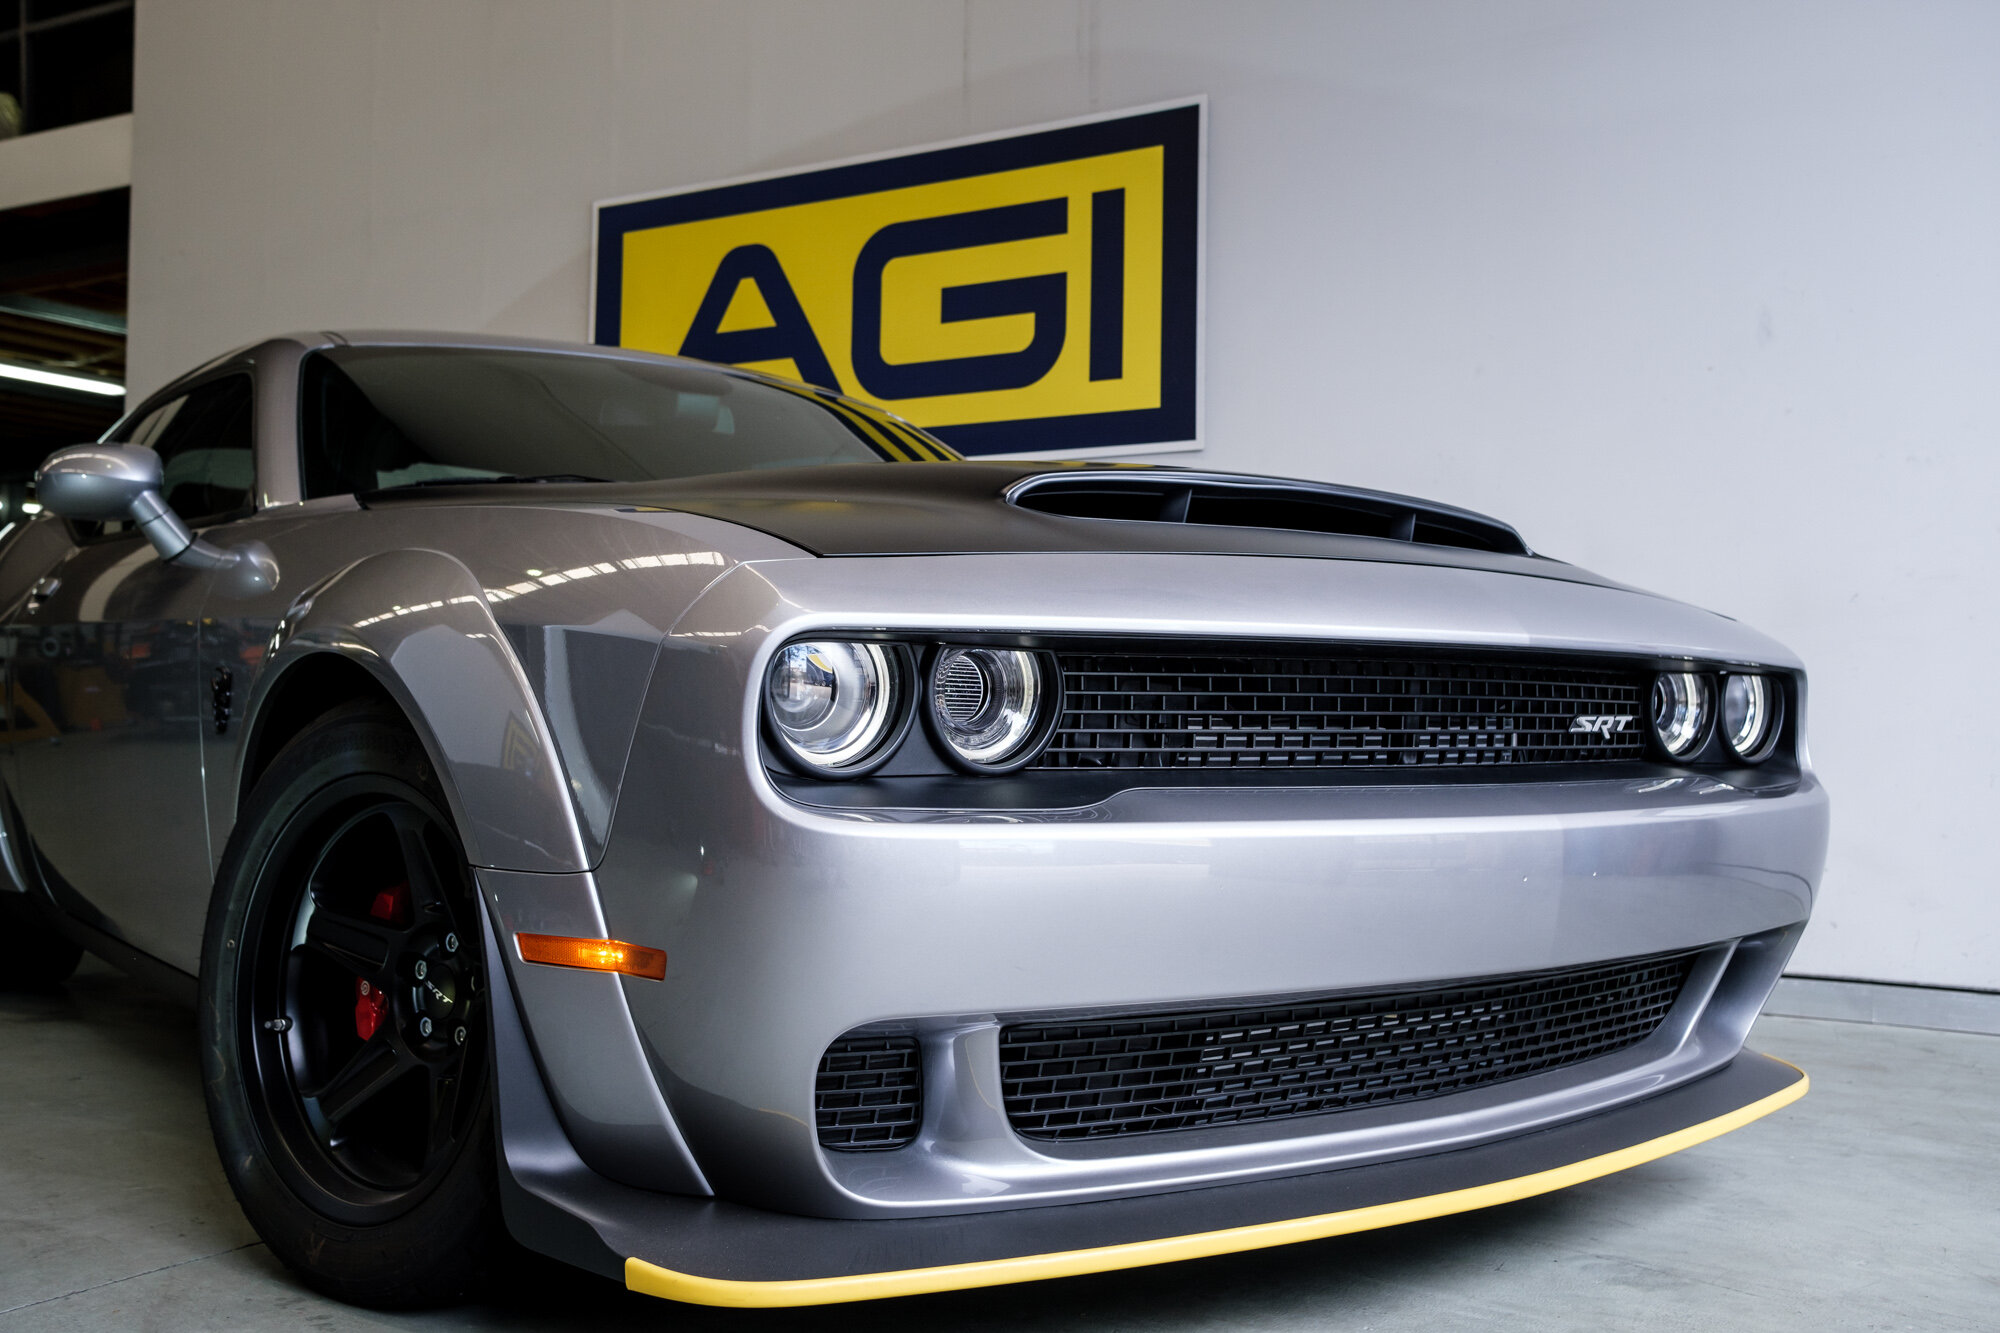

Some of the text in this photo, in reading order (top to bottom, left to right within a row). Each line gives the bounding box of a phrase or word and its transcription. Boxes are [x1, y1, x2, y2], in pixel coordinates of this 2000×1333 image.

[678, 187, 1126, 401] AGI
[1570, 715, 1634, 739] SRT
[425, 980, 454, 1003] SRT
